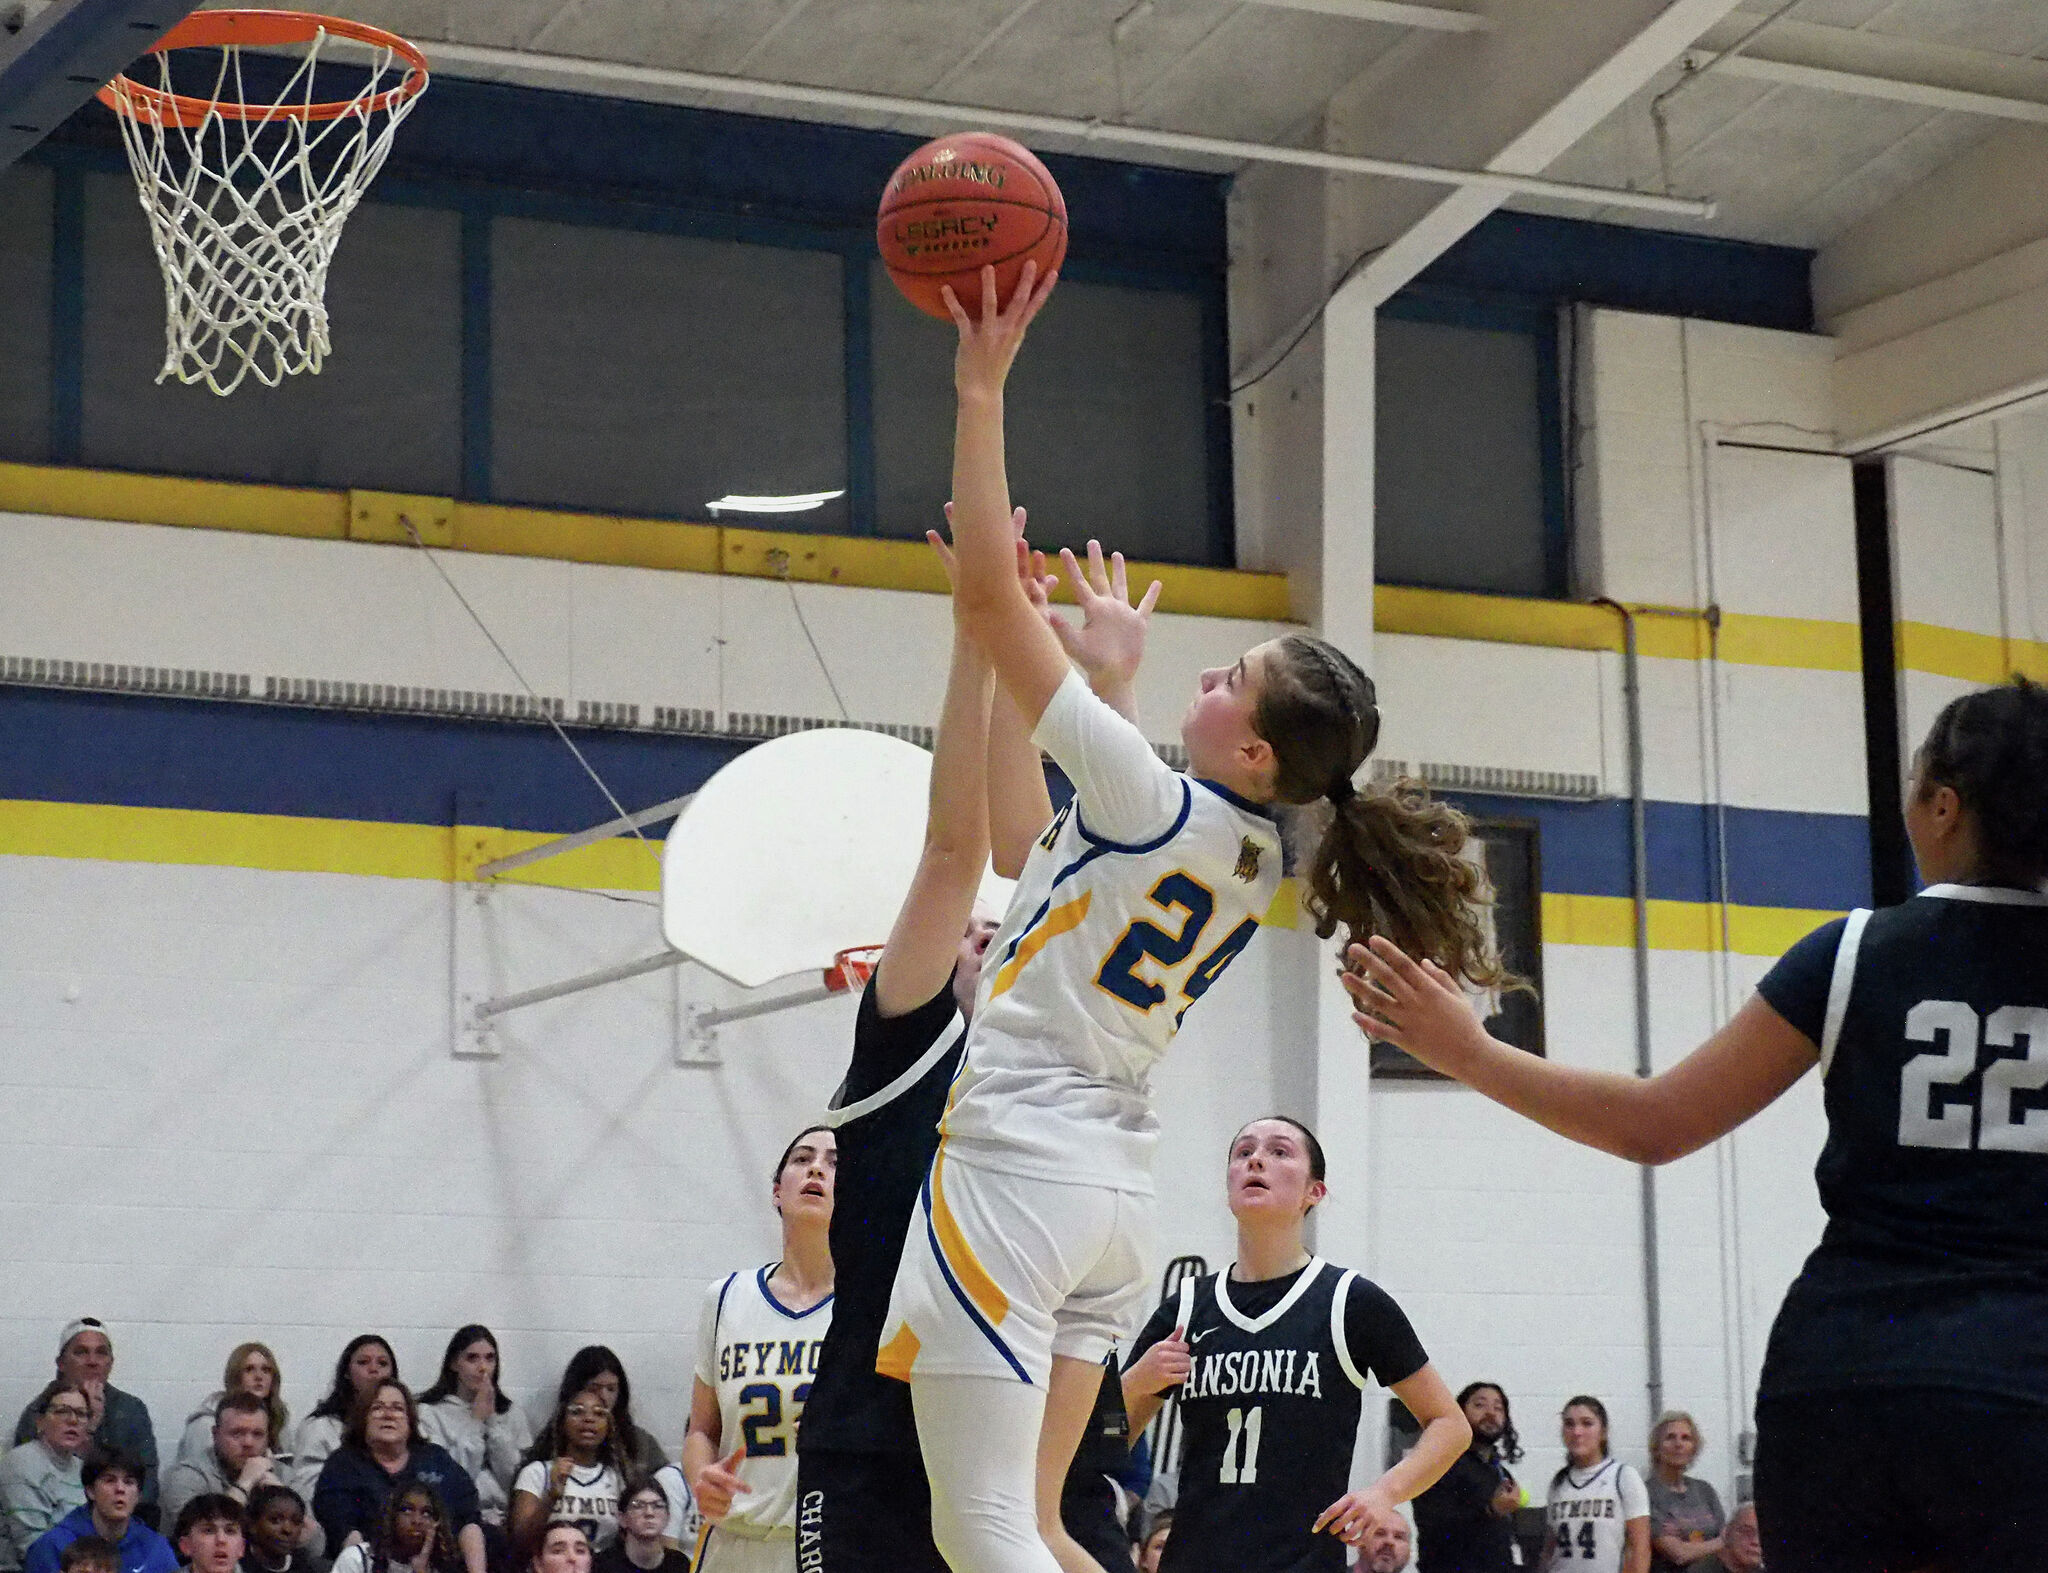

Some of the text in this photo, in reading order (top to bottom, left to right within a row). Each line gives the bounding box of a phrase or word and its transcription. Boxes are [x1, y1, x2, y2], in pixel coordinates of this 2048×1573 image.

[895, 212, 999, 240] LEGACY
[1898, 999, 2048, 1154] 22
[1181, 1348, 1322, 1401] ANSONIA
[1219, 1405, 1262, 1484] 11
[1556, 1520, 1597, 1560] 44
